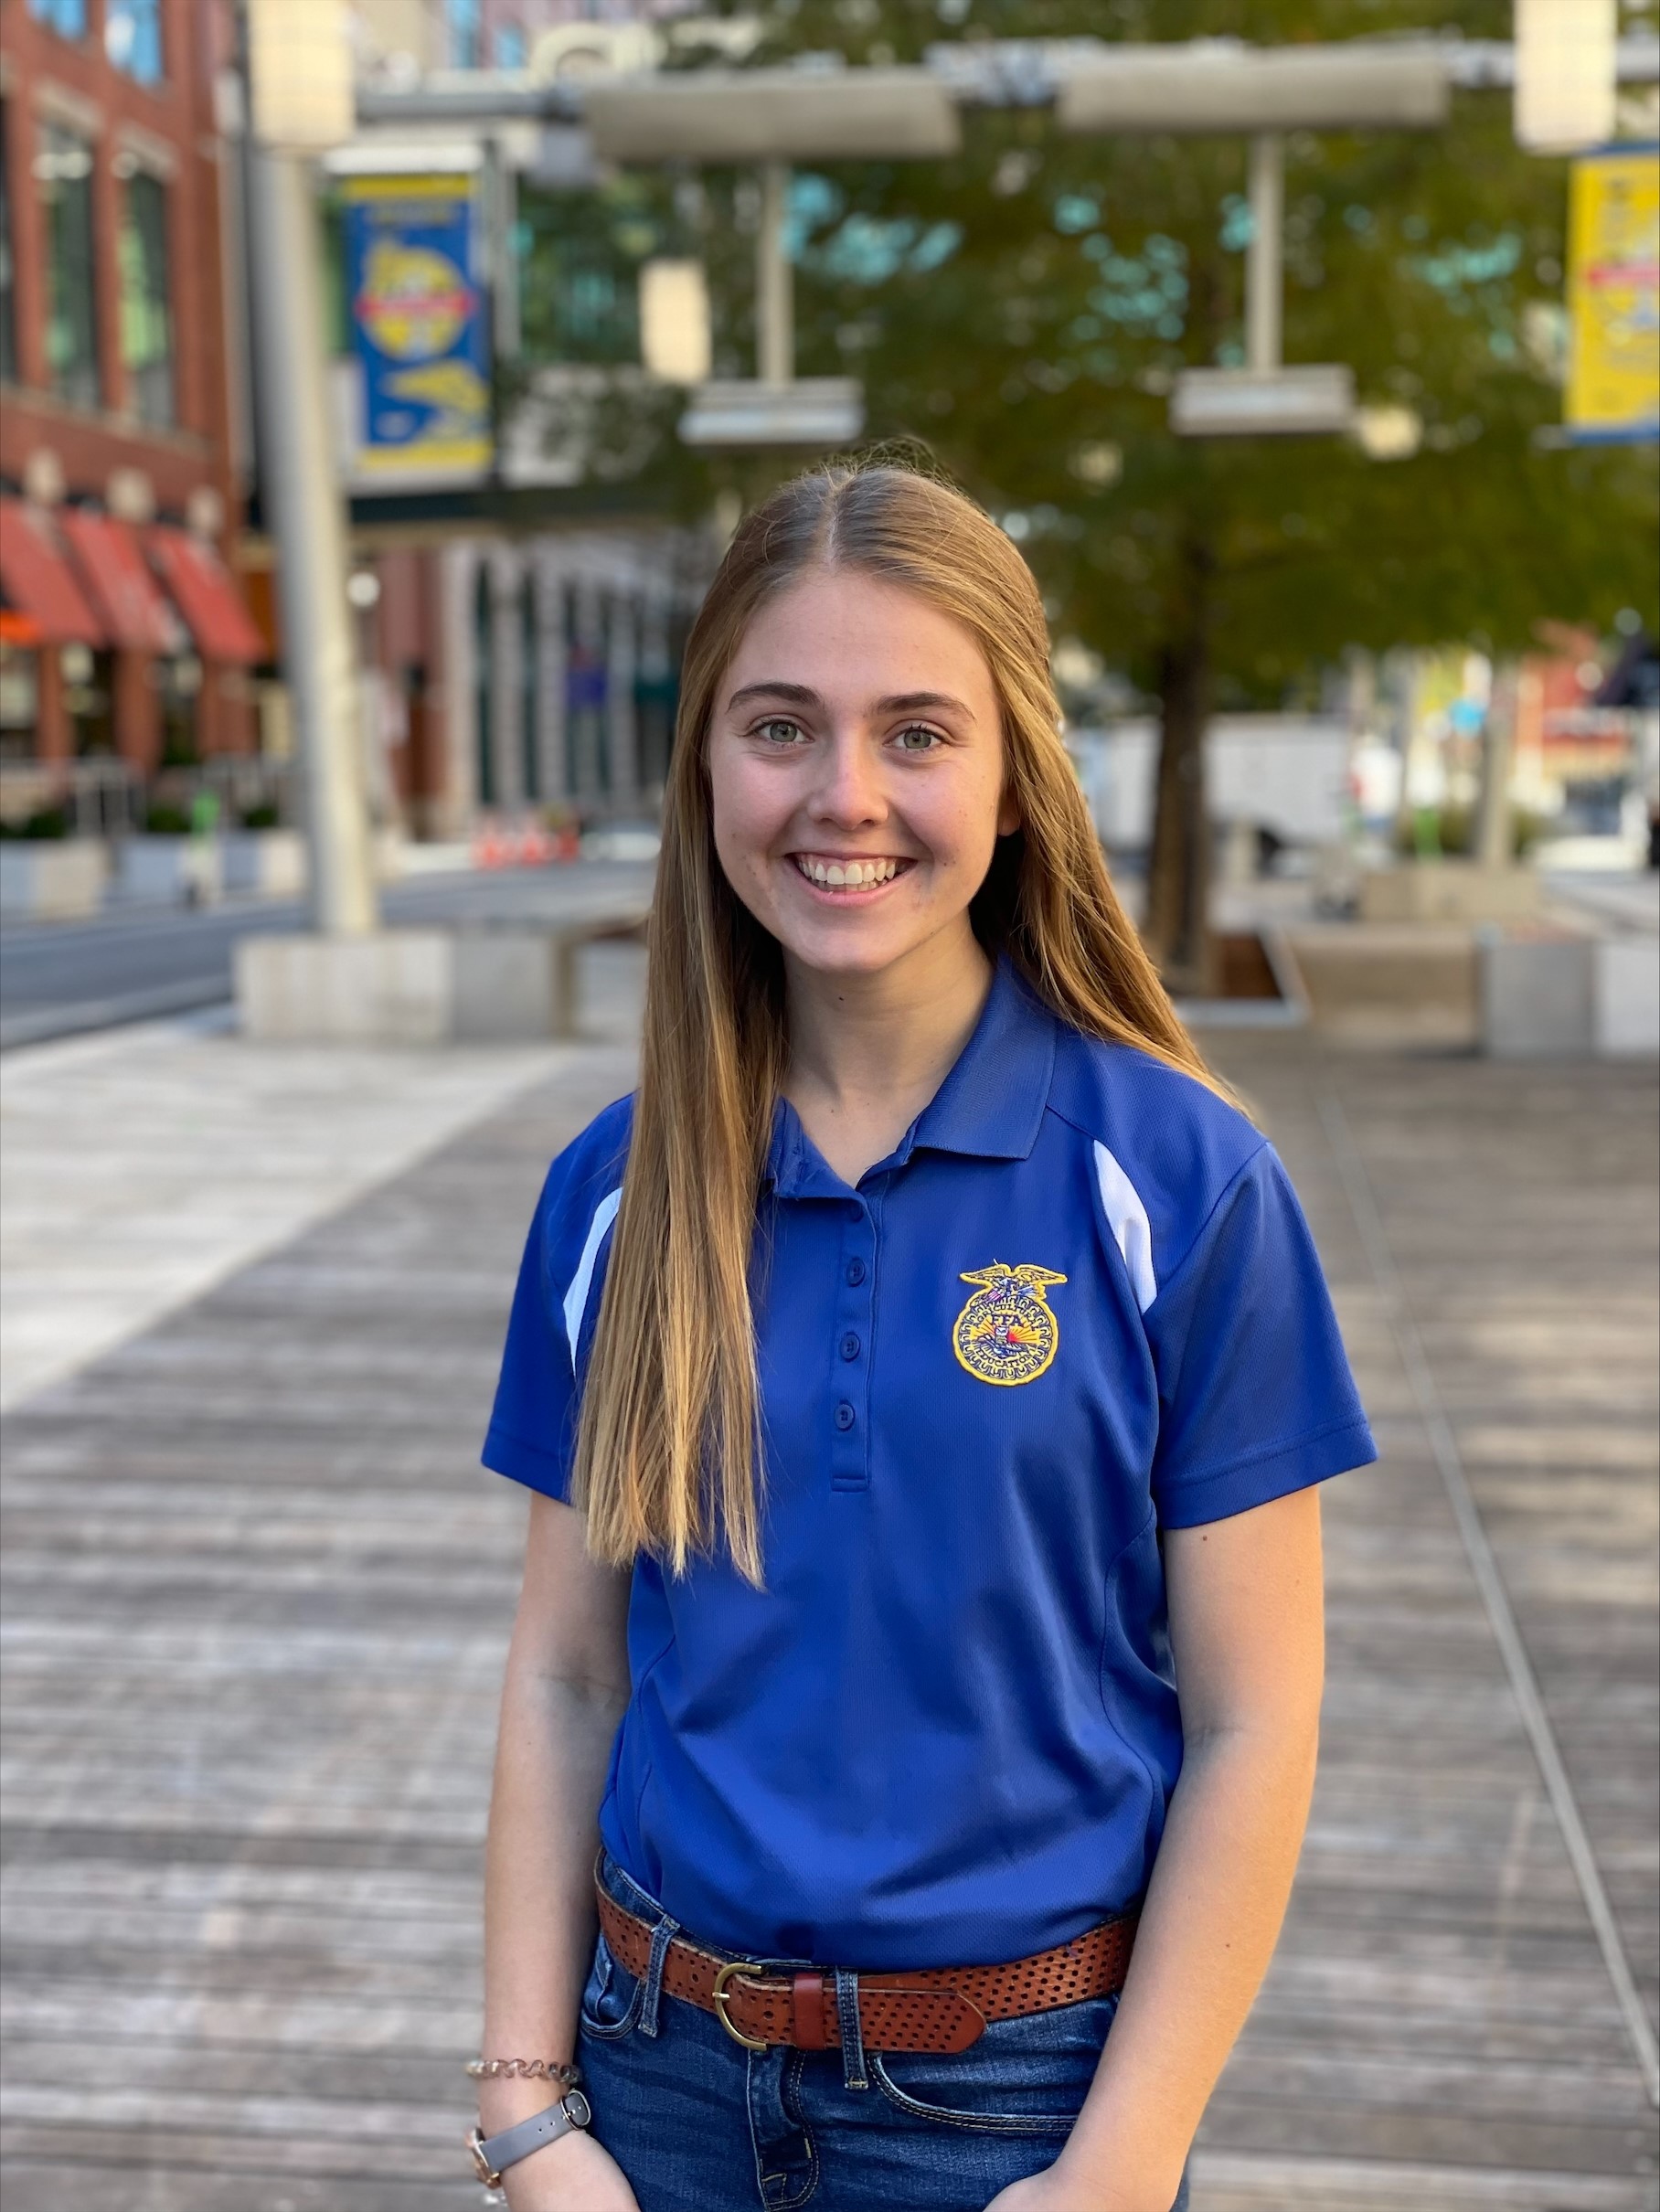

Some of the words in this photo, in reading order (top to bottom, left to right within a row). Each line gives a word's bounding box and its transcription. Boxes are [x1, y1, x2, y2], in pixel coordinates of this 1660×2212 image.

[974, 1303, 1038, 1331] AGRICULTURAL
[991, 1313, 1024, 1326] FFA
[975, 1348, 1034, 1368] EDUCATION
